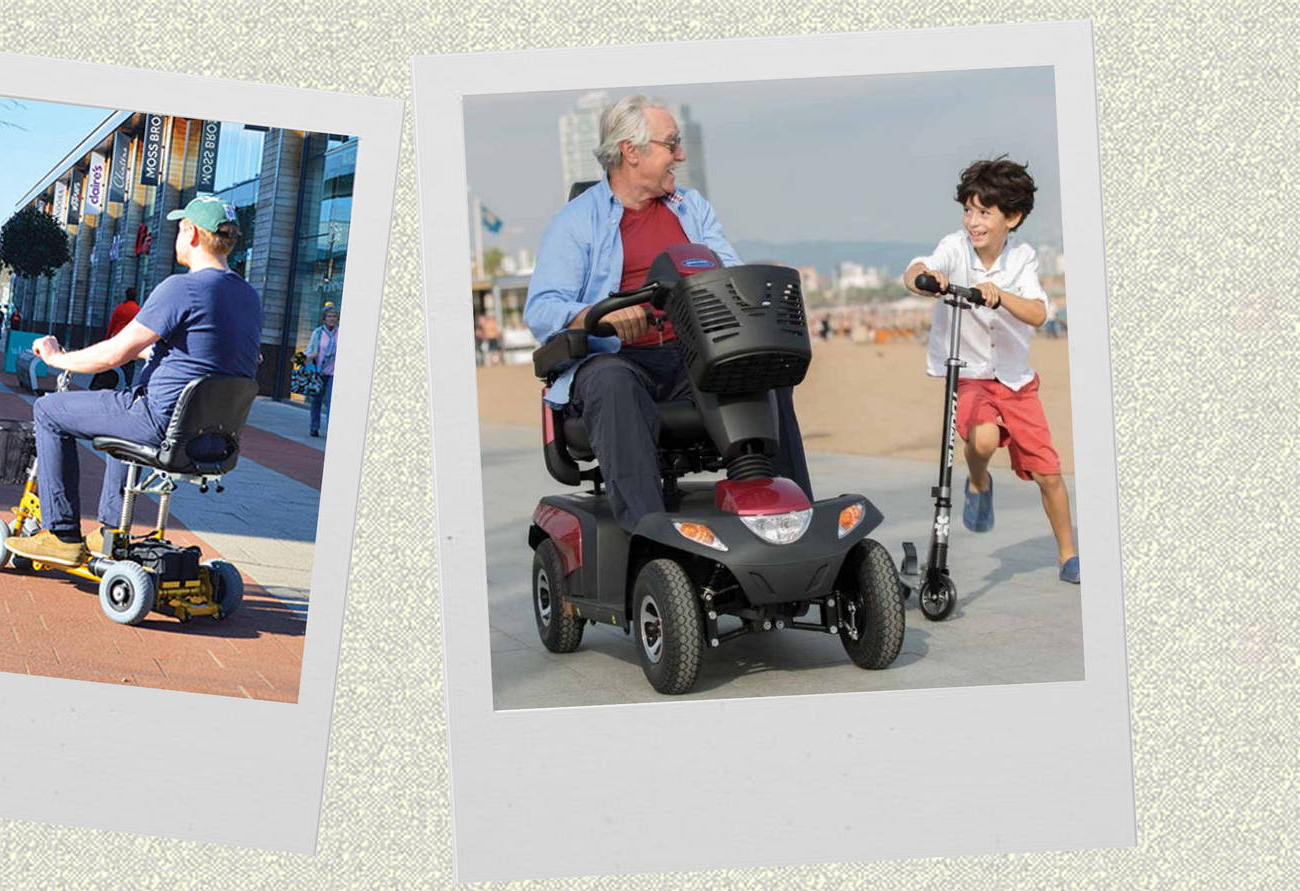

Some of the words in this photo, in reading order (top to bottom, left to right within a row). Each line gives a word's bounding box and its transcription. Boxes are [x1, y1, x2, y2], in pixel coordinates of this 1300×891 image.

[149, 114, 163, 142] BRO
[145, 143, 159, 179] MOSS
[88, 165, 103, 205] claire's
